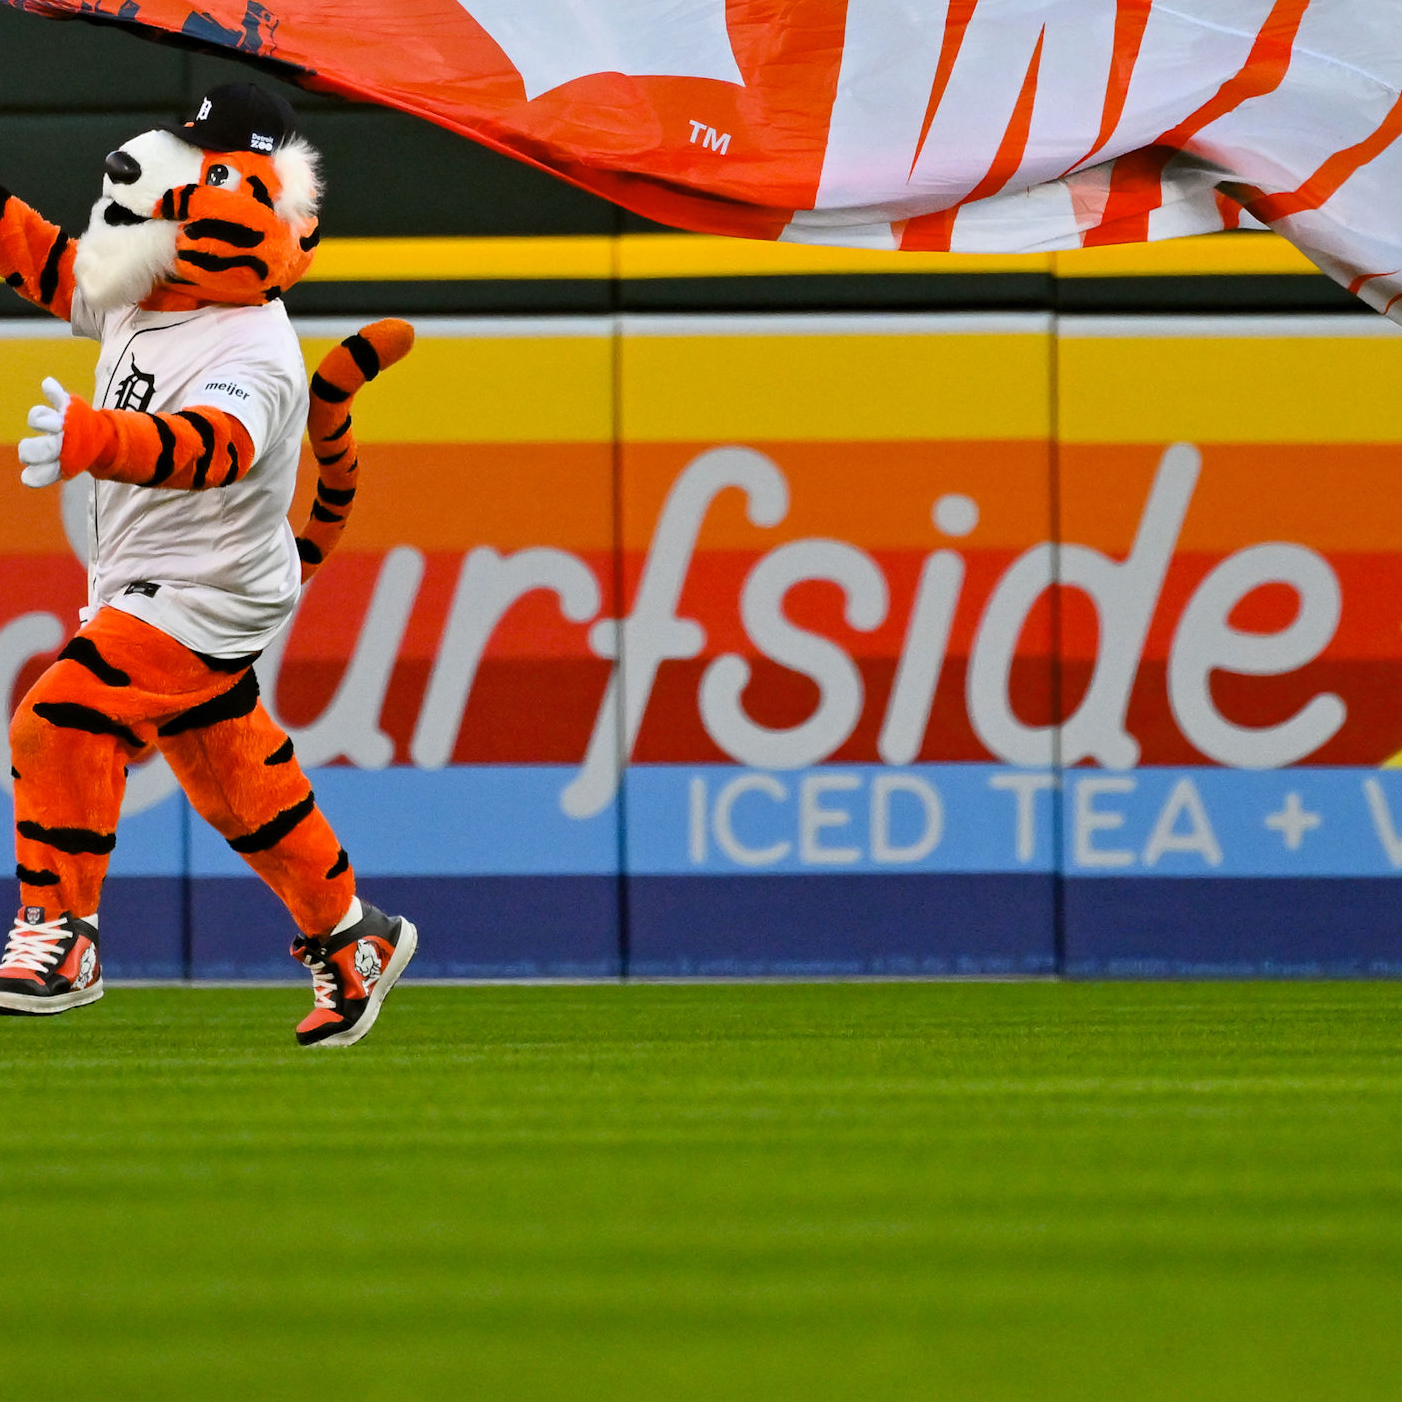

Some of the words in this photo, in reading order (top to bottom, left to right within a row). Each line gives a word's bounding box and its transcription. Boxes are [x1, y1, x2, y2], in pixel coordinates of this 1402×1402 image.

[251, 132, 274, 144] Detroit
[688, 119, 732, 156] TM
[114, 351, 156, 412] D
[204, 381, 250, 401] meijer
[689, 772, 944, 867] ICED
[988, 770, 1223, 869] TEA
[1265, 792, 1321, 849] +
